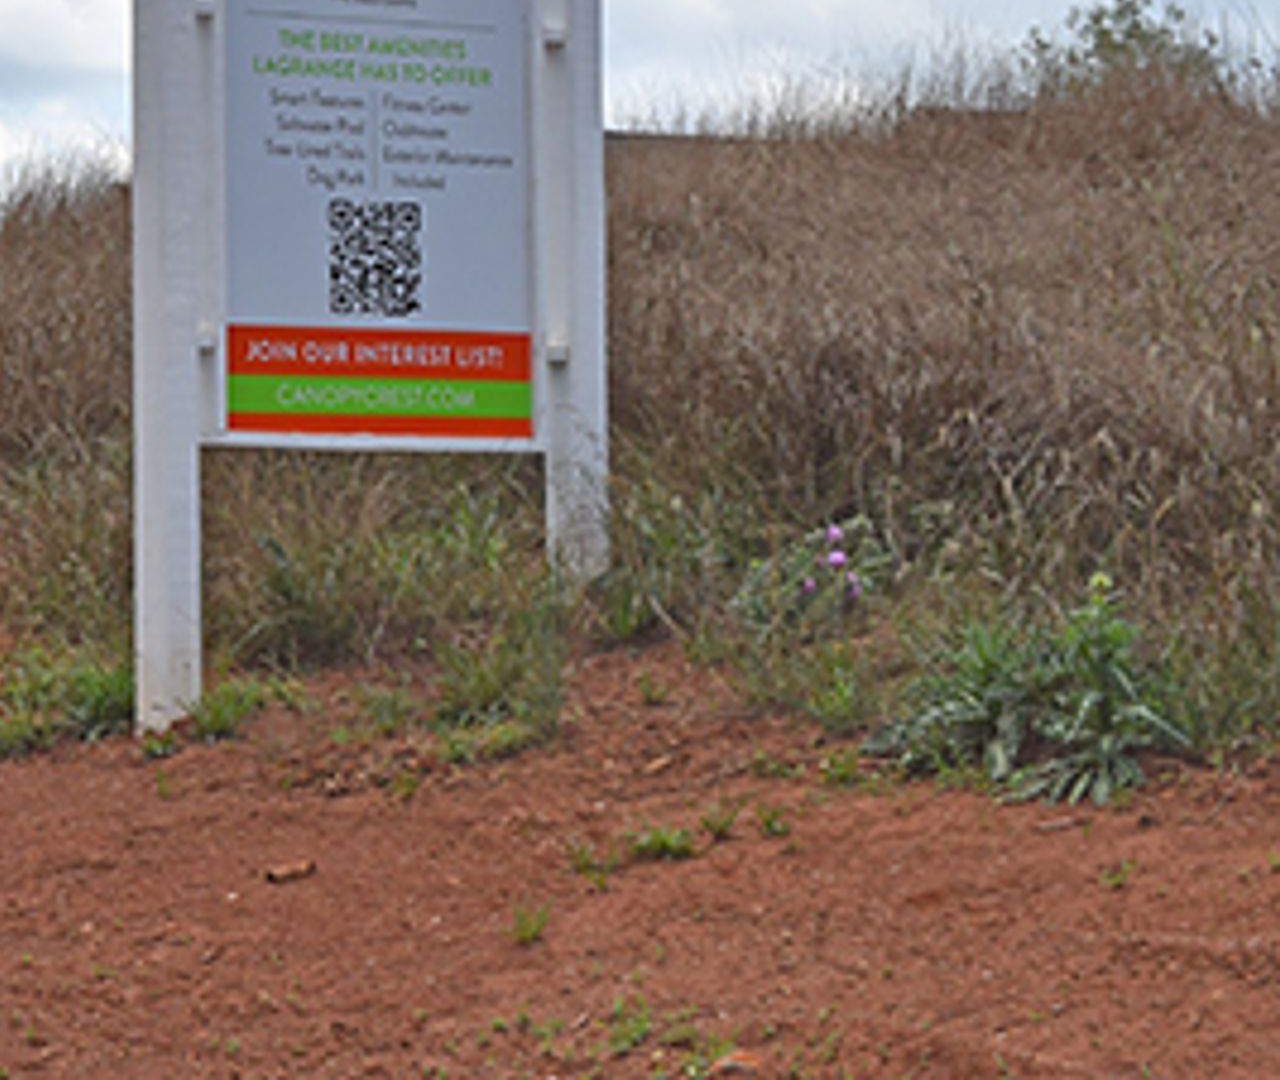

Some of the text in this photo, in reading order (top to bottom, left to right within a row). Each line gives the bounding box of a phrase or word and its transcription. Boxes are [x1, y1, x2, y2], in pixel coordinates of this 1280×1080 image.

[278, 28, 466, 60] THE BEST AMENITIES
[252, 54, 492, 88] LAGRANGE HAS TO OFFER
[268, 86, 365, 109] Smart Features
[245, 339, 504, 370] JOIN OUR INTEREST LIST!
[275, 383, 476, 410] CANOPYCREST.COM
